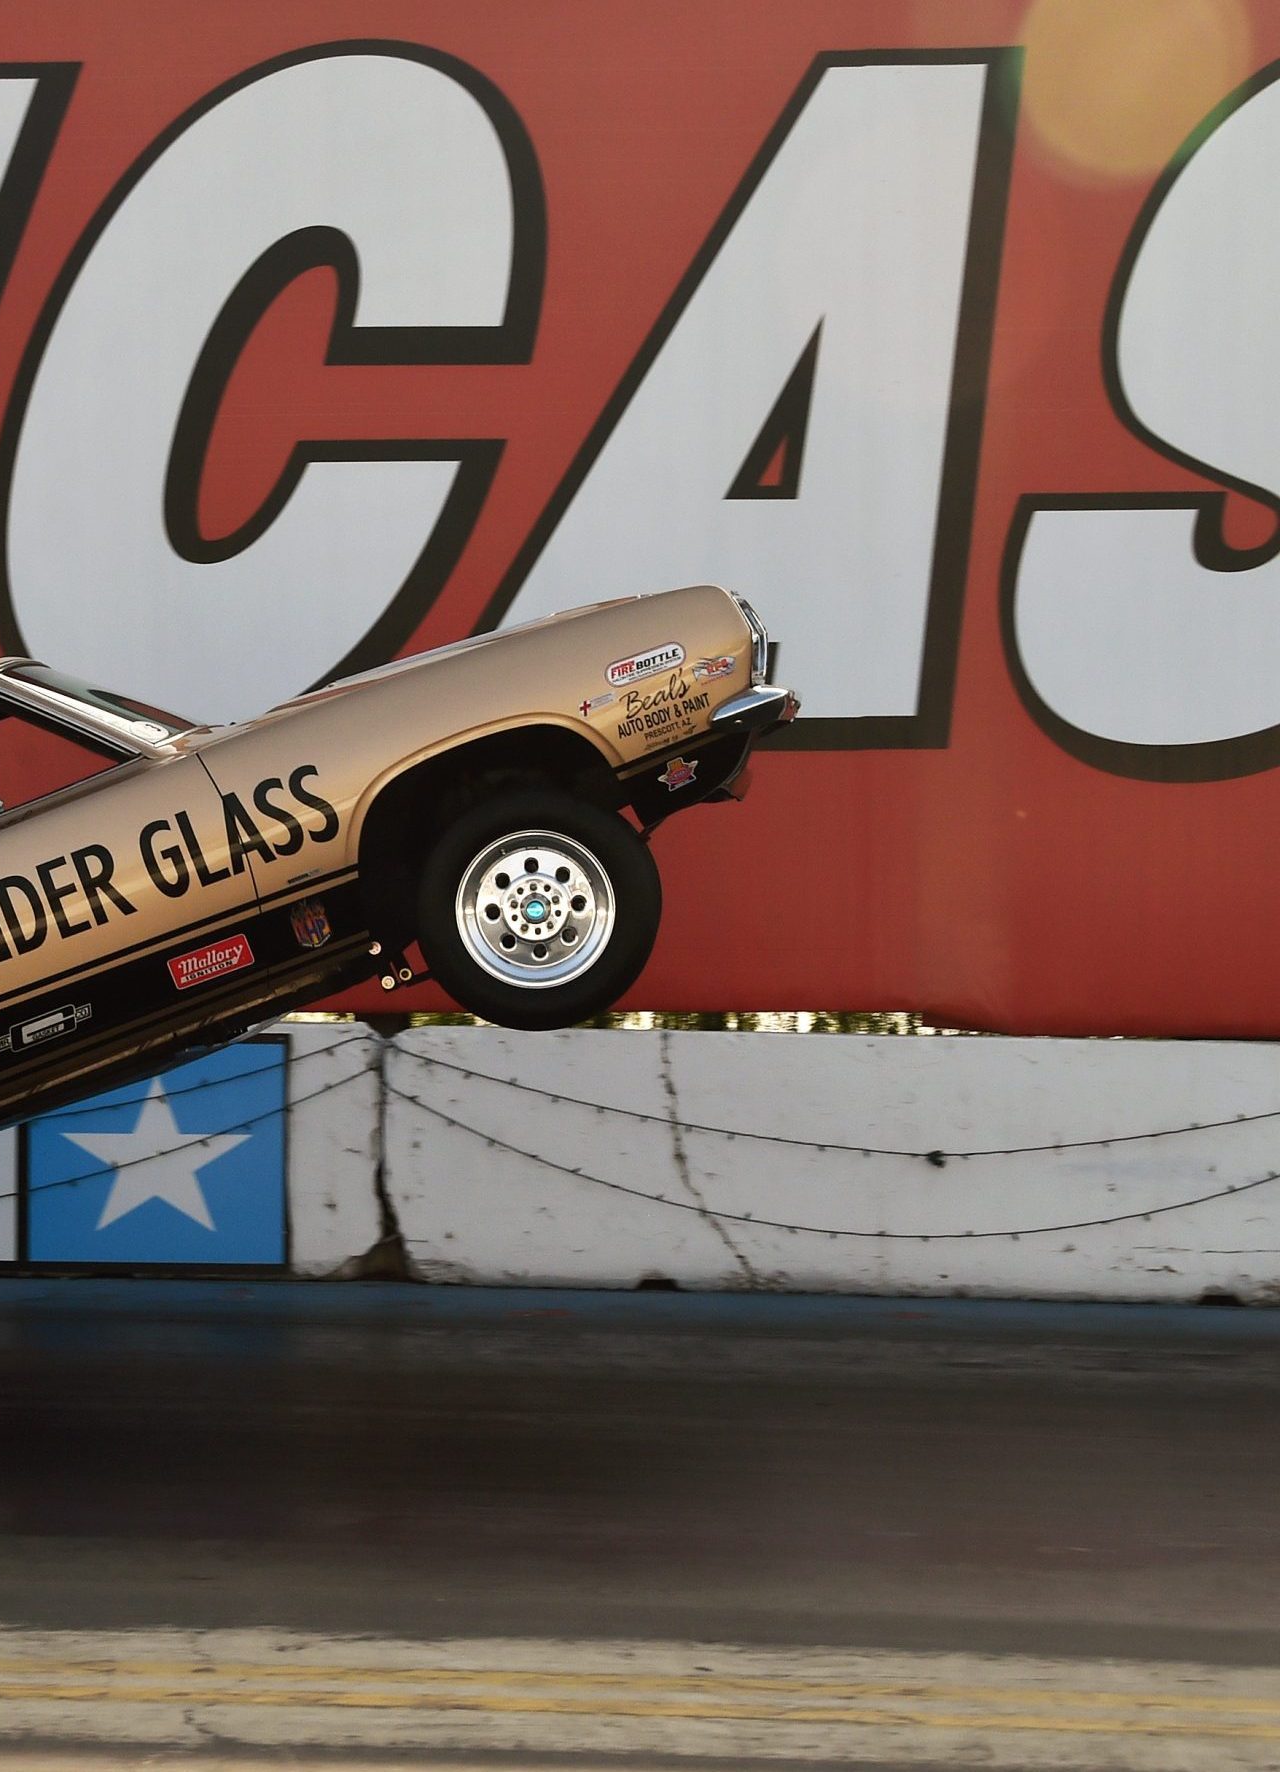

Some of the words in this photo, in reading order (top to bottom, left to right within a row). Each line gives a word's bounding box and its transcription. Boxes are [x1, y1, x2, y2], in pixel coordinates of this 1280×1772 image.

[617, 717, 644, 739] AUTO
[644, 707, 670, 729] BODY
[674, 703, 682, 718] &
[682, 692, 710, 714] PAINT
[619, 668, 690, 719] Beal's
[140, 764, 340, 898] GLASS
[178, 944, 243, 975] Mallory
[186, 960, 233, 981] IGNITION
